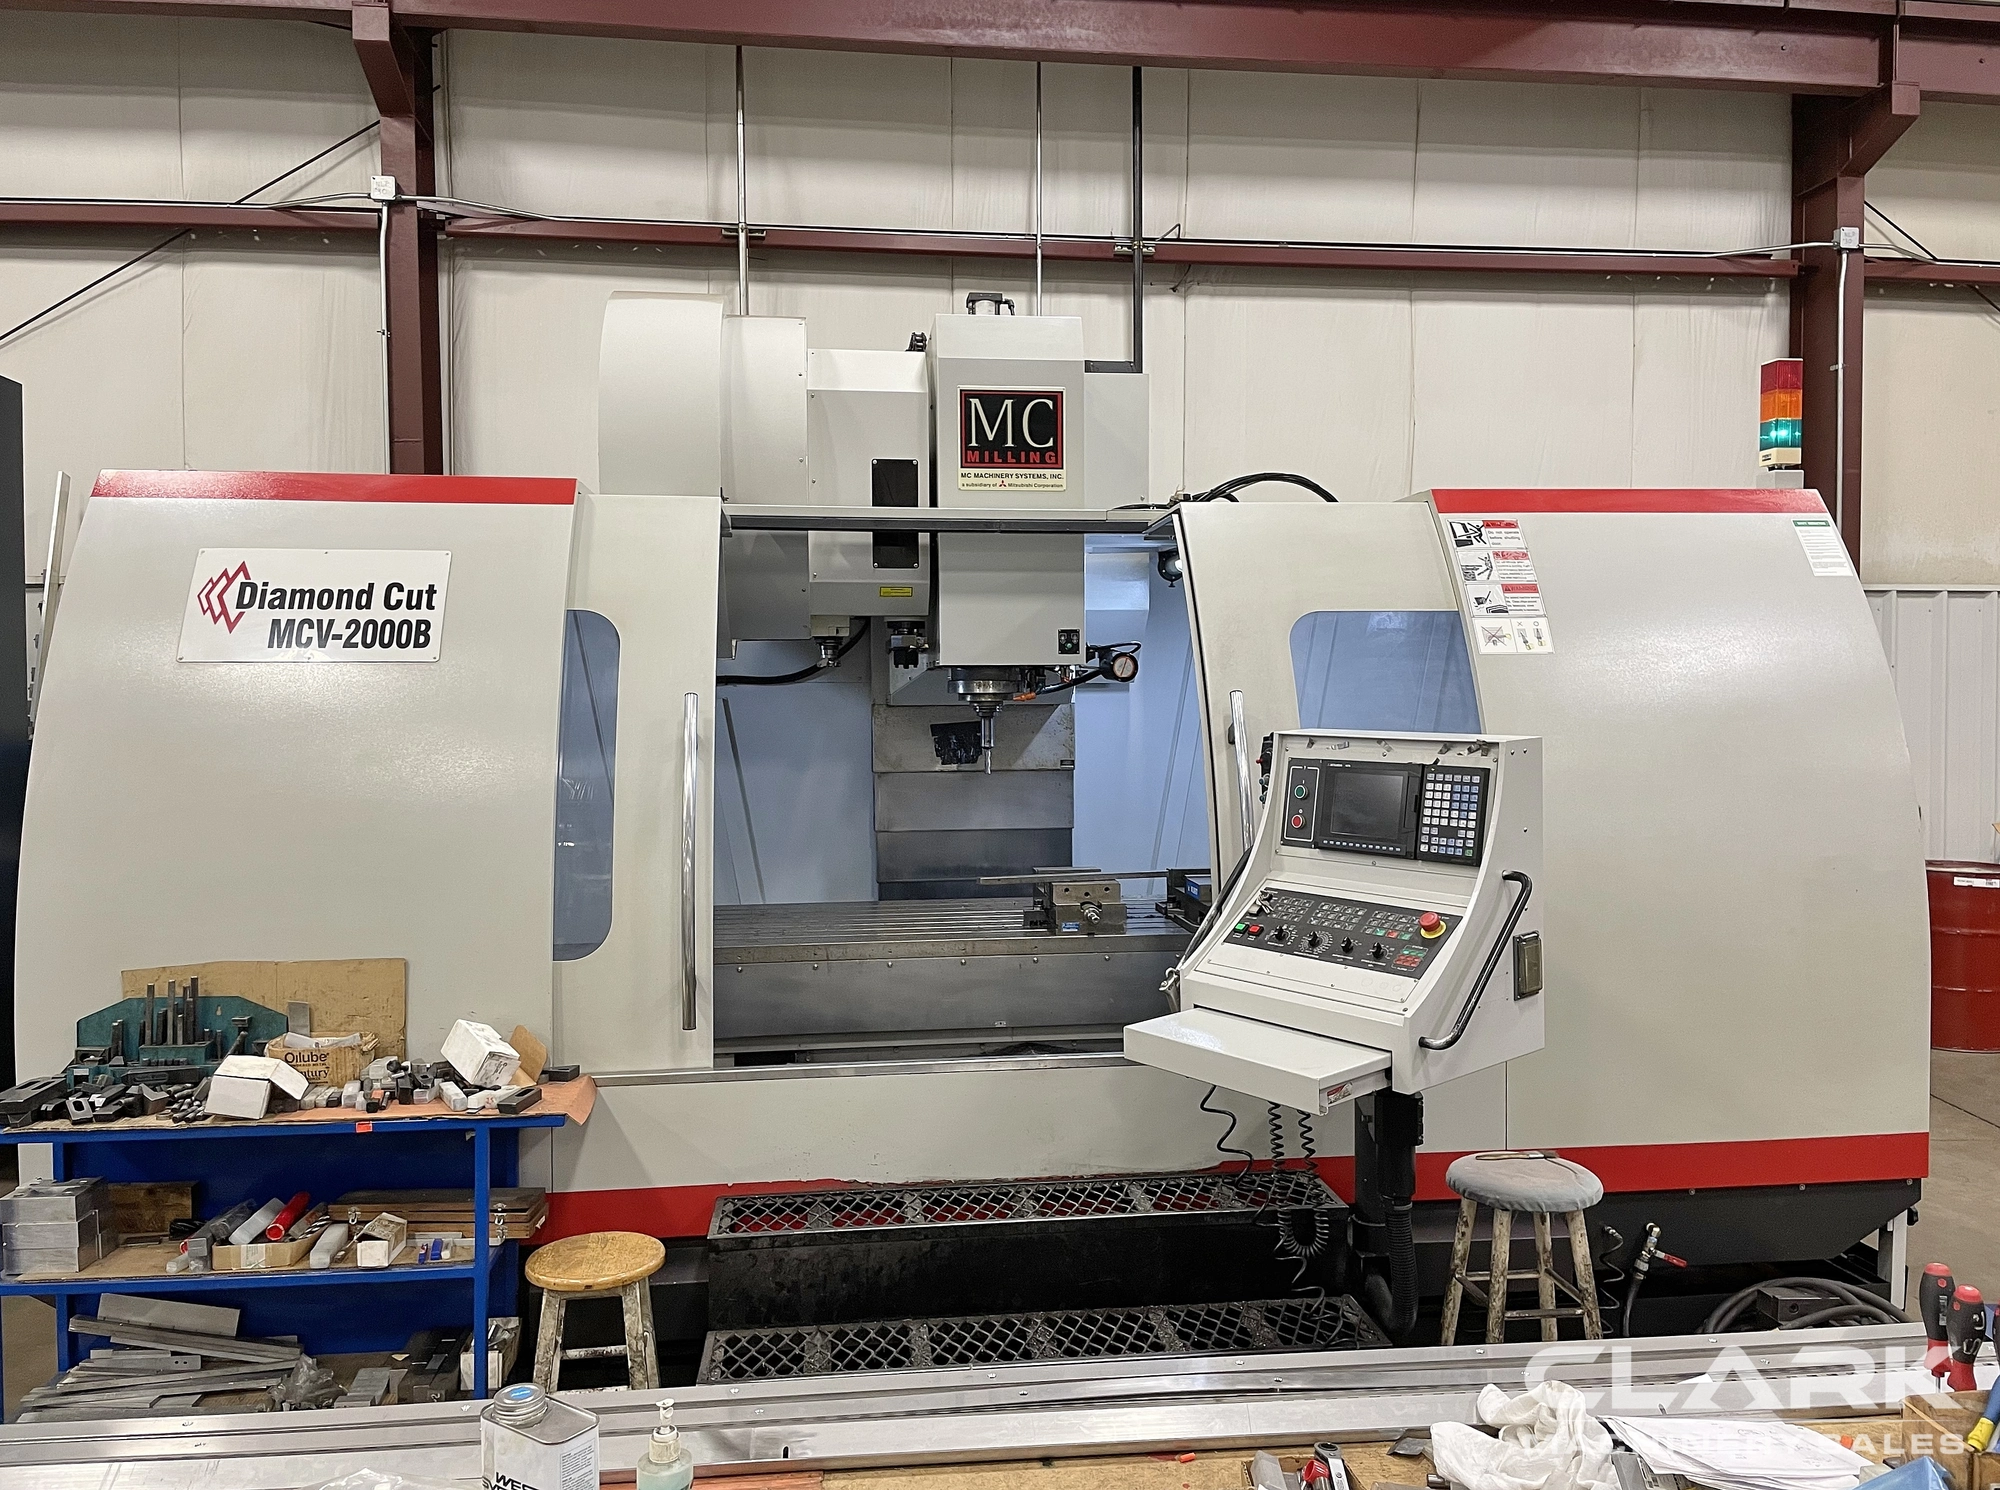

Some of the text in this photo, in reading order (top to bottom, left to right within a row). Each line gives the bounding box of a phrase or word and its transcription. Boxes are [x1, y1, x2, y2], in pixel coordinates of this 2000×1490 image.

[967, 398, 1055, 448] MC
[966, 450, 1057, 464] MILLING
[235, 581, 437, 611] Diamond Cut
[267, 618, 431, 649] MCV-2000B
